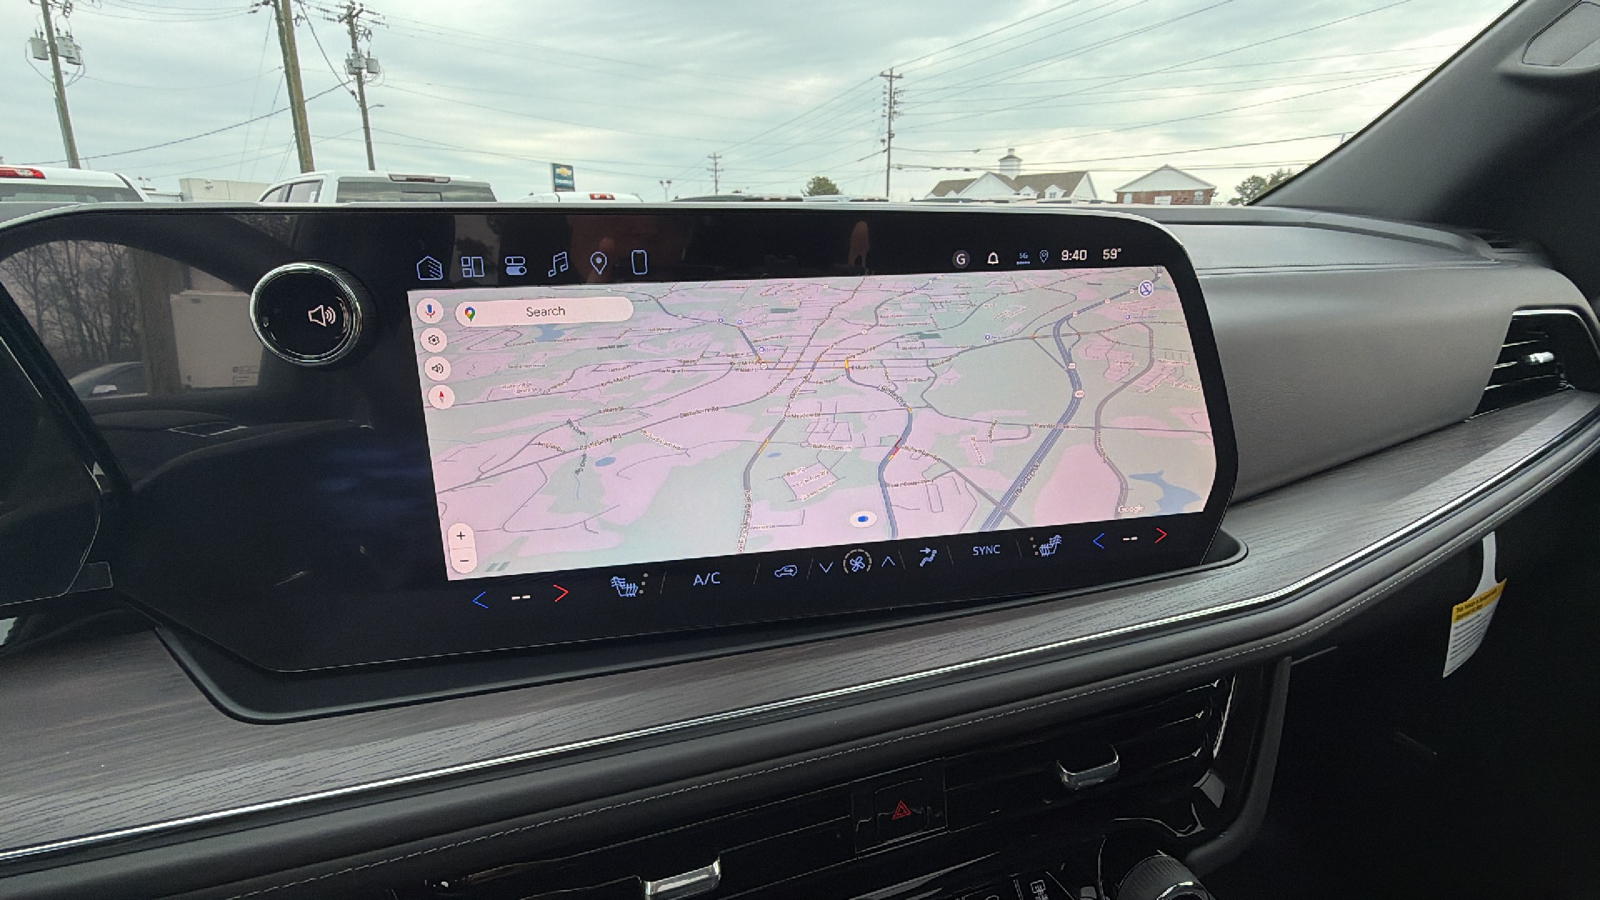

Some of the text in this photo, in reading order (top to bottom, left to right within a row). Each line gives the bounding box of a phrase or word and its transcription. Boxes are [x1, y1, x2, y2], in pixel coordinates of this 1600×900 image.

[956, 253, 966, 265] G
[1061, 249, 1088, 261] 9:40
[1102, 247, 1122, 260] 59°
[526, 306, 566, 317] Search
[972, 544, 1001, 556] SYNC
[692, 572, 721, 586] A/C
